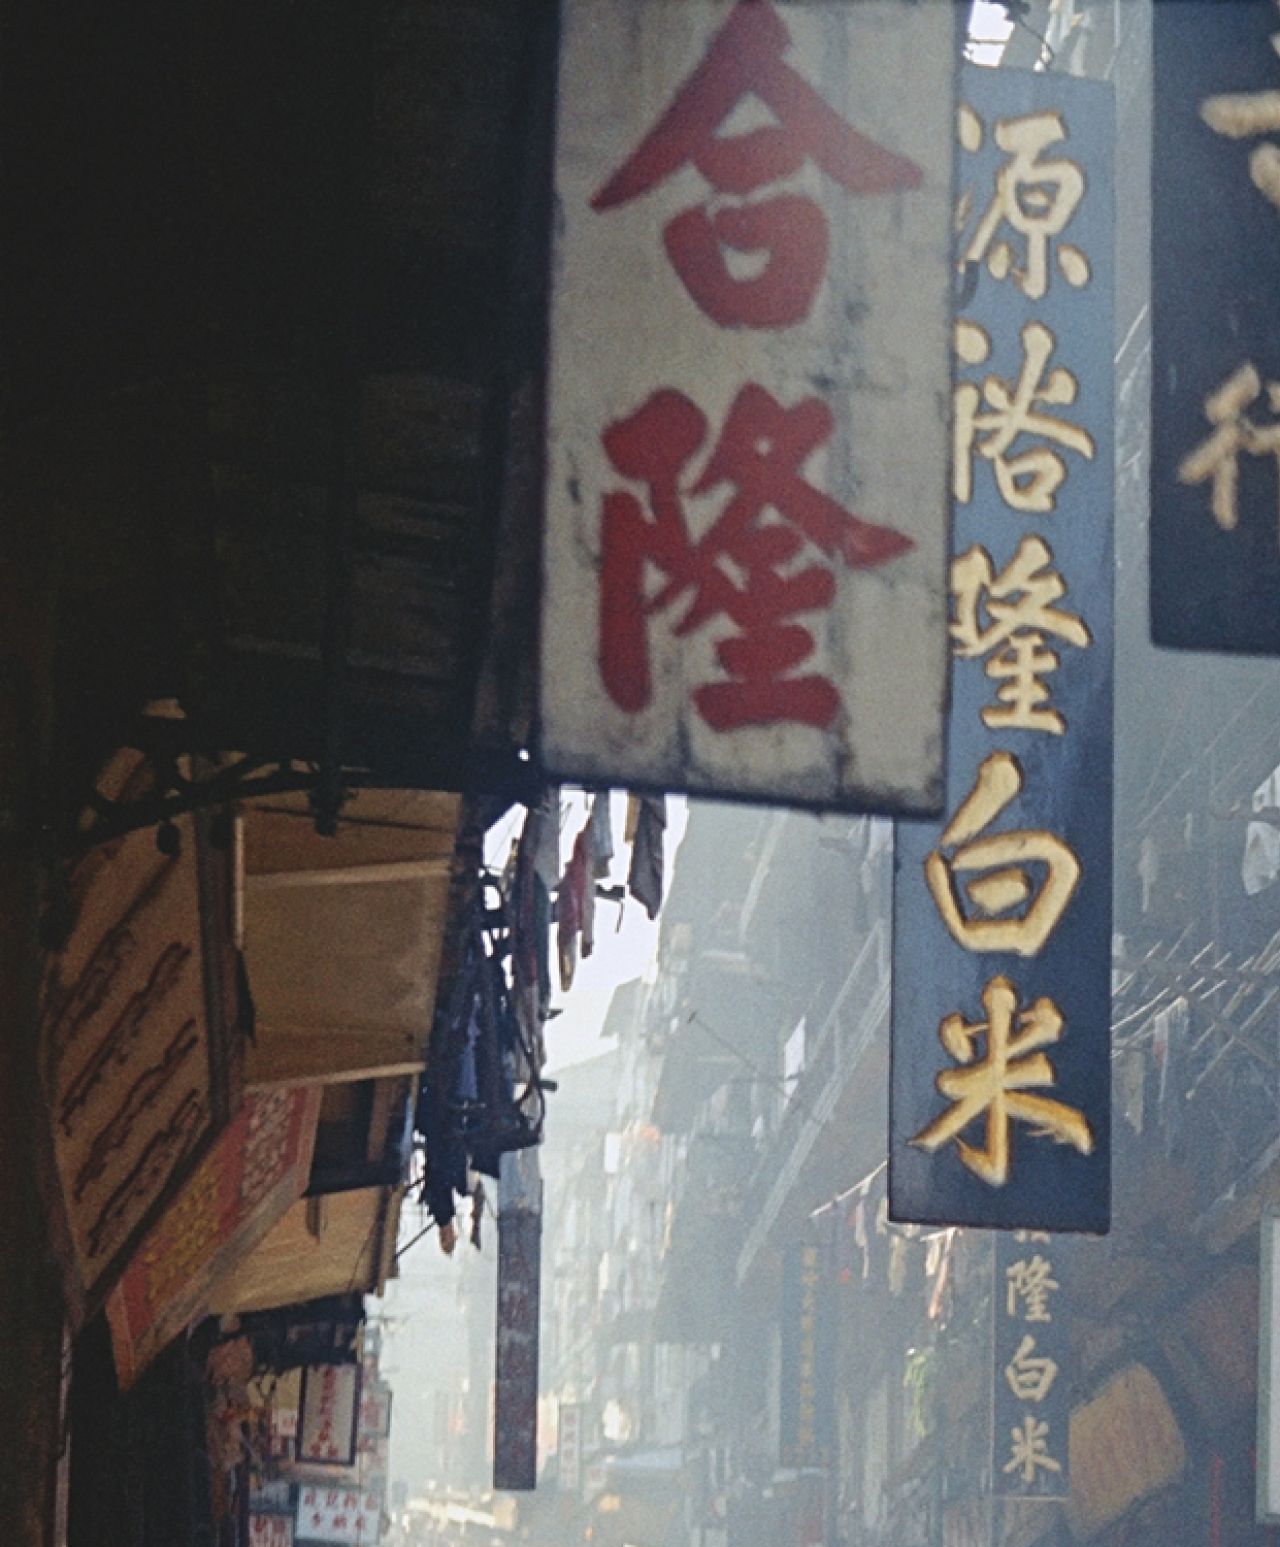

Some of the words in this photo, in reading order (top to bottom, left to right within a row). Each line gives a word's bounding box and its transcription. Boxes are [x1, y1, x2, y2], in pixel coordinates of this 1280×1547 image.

[589, 0, 926, 733] 合隆
[1002, 1230, 1061, 1483] 隆白米
